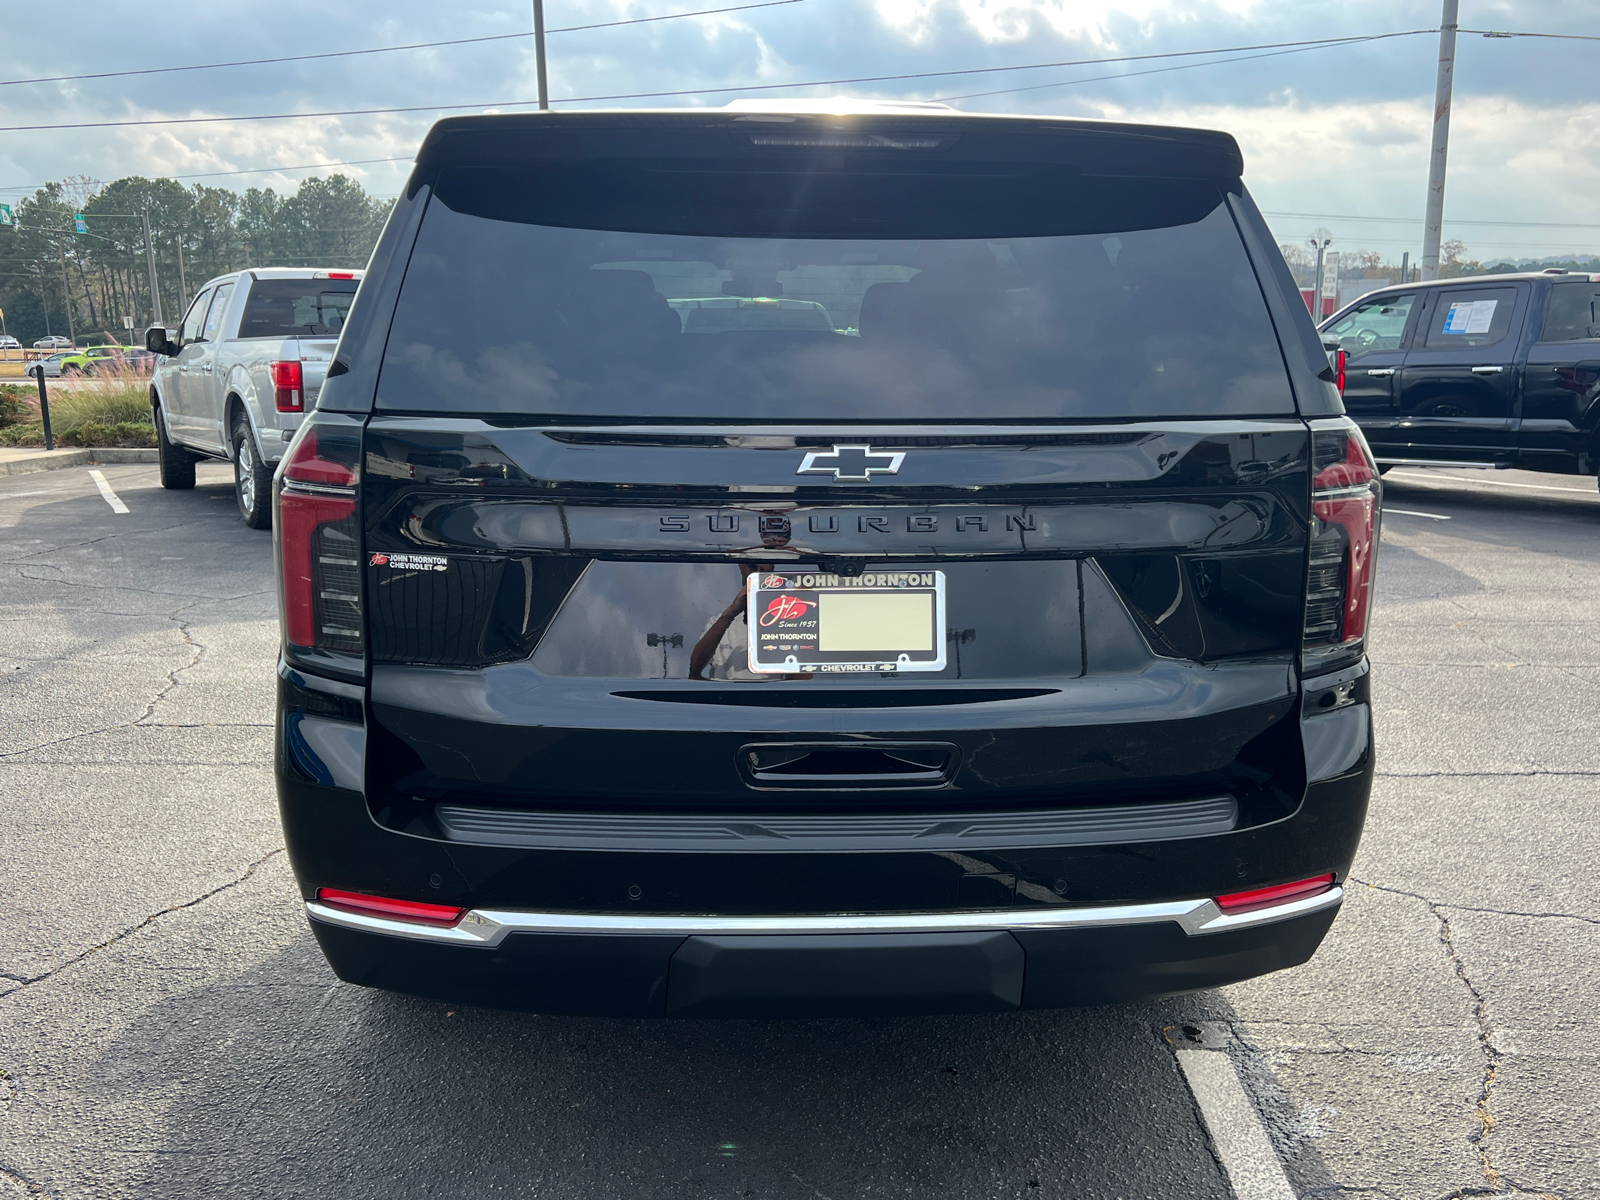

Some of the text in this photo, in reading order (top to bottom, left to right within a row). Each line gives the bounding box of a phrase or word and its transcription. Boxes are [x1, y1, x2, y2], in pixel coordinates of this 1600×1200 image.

[659, 513, 1038, 533] SUBURBAN
[390, 554, 447, 565] JOHN THORNTON
[390, 562, 433, 570] CHEVROLET
[794, 574, 839, 587] JOHN
[843, 574, 933, 587] THORNTON
[778, 620, 817, 628] Since 1957
[820, 664, 876, 672] CHEVROLET
